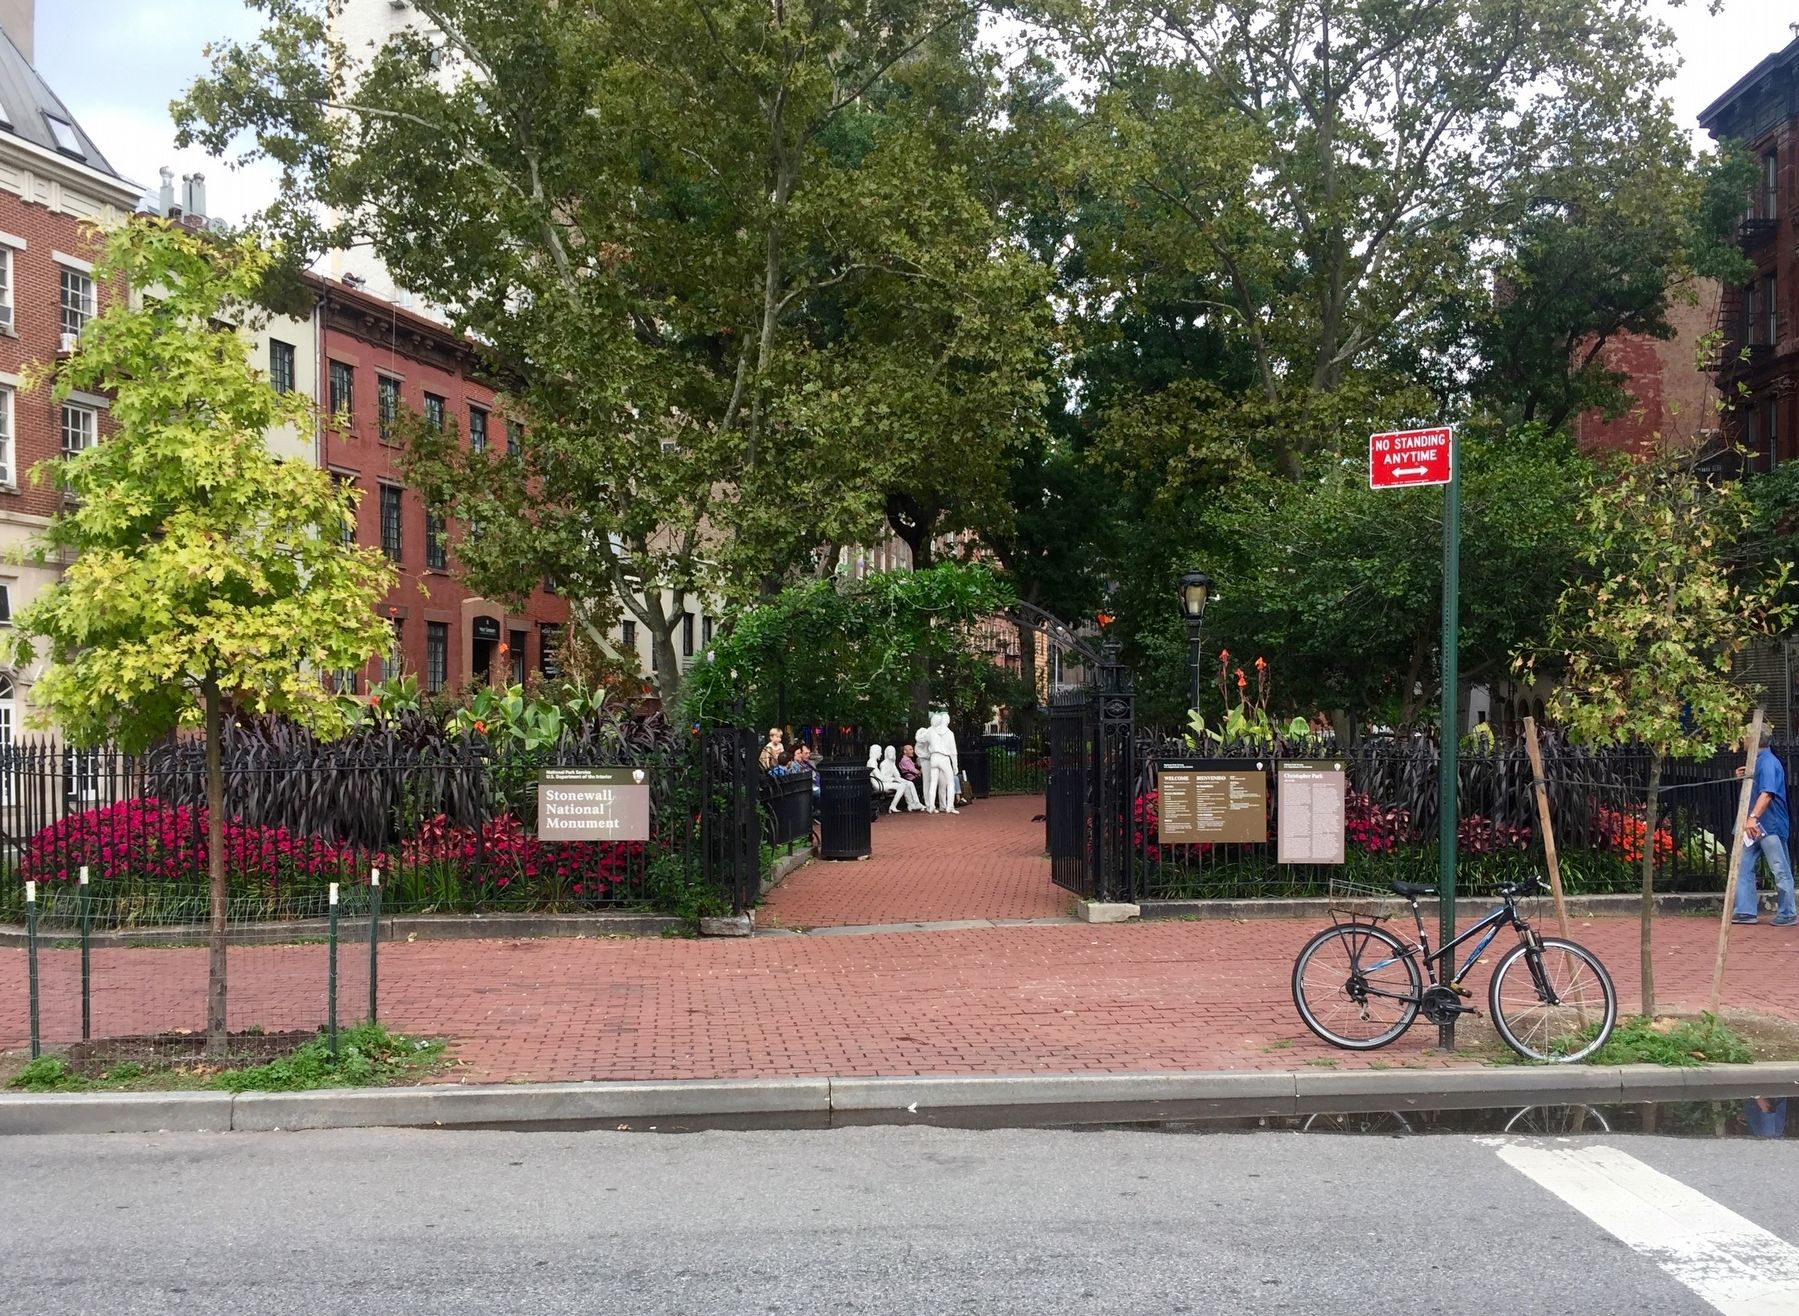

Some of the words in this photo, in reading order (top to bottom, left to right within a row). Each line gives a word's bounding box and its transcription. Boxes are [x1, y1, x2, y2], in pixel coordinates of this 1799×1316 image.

[1375, 439, 1390, 451] NO
[1394, 434, 1446, 449] STANDING
[1384, 449, 1437, 464] ANYTIME
[546, 789, 613, 801] Stonewall
[546, 803, 604, 815] National
[546, 817, 620, 828] Monument
